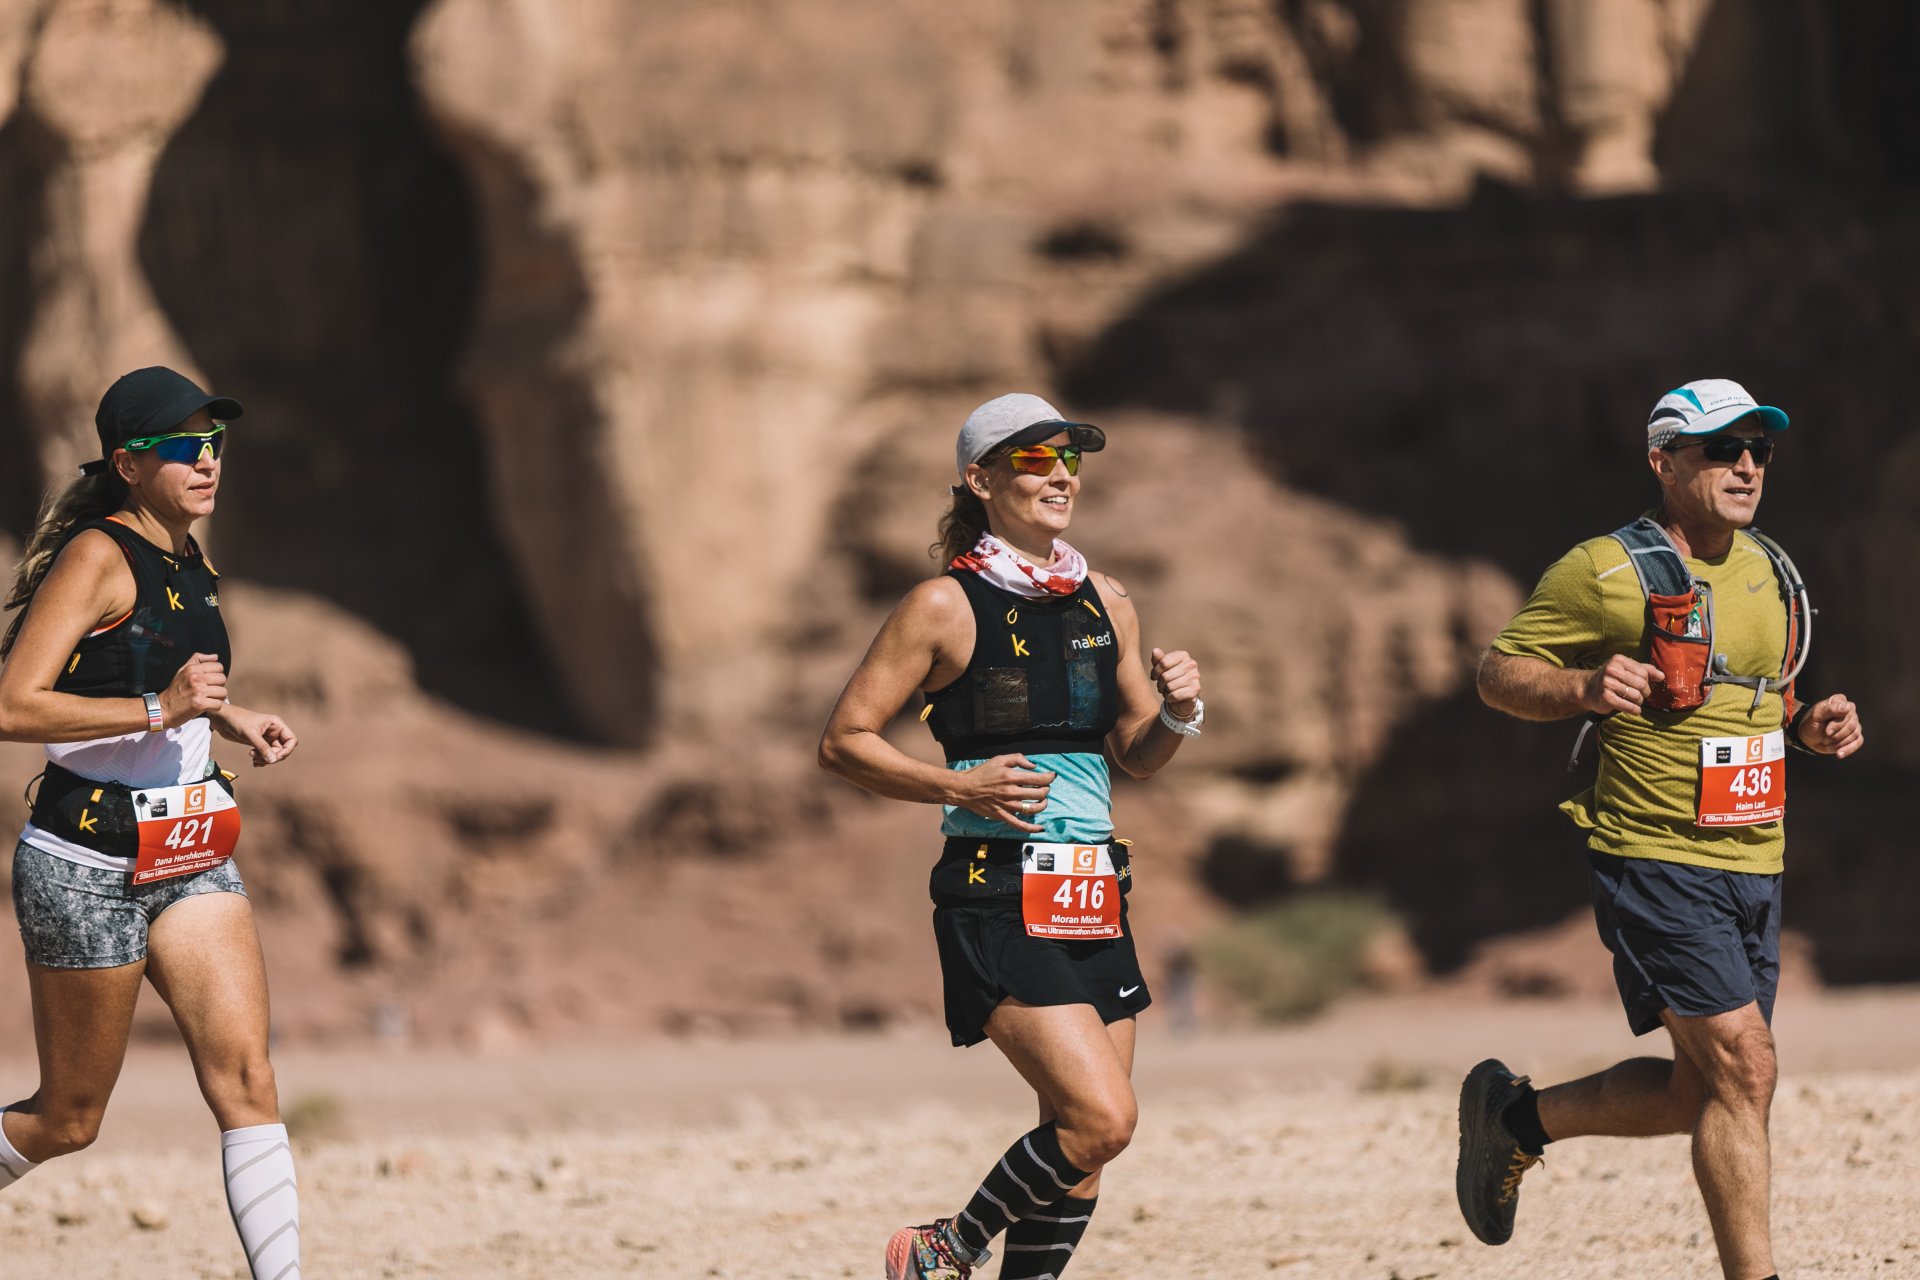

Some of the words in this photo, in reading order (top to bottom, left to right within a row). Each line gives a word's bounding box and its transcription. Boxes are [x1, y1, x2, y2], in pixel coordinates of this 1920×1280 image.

[1072, 633, 1111, 649] naked
[1729, 766, 1772, 797] 436
[1736, 802, 1753, 811] Haim
[1754, 800, 1766, 809] Last
[1705, 814, 1723, 823] 55km
[1724, 812, 1761, 822] Ultramarathon
[165, 816, 214, 849] 421
[155, 857, 172, 867] Dana
[174, 849, 215, 863] Hershkovits
[139, 869, 154, 880] 55km
[155, 862, 193, 876] Ultramarathon
[1053, 879, 1105, 910] 416
[1051, 914, 1079, 923] Moran
[1080, 914, 1102, 924] Michel
[1048, 926, 1091, 936] Ultramarathon
